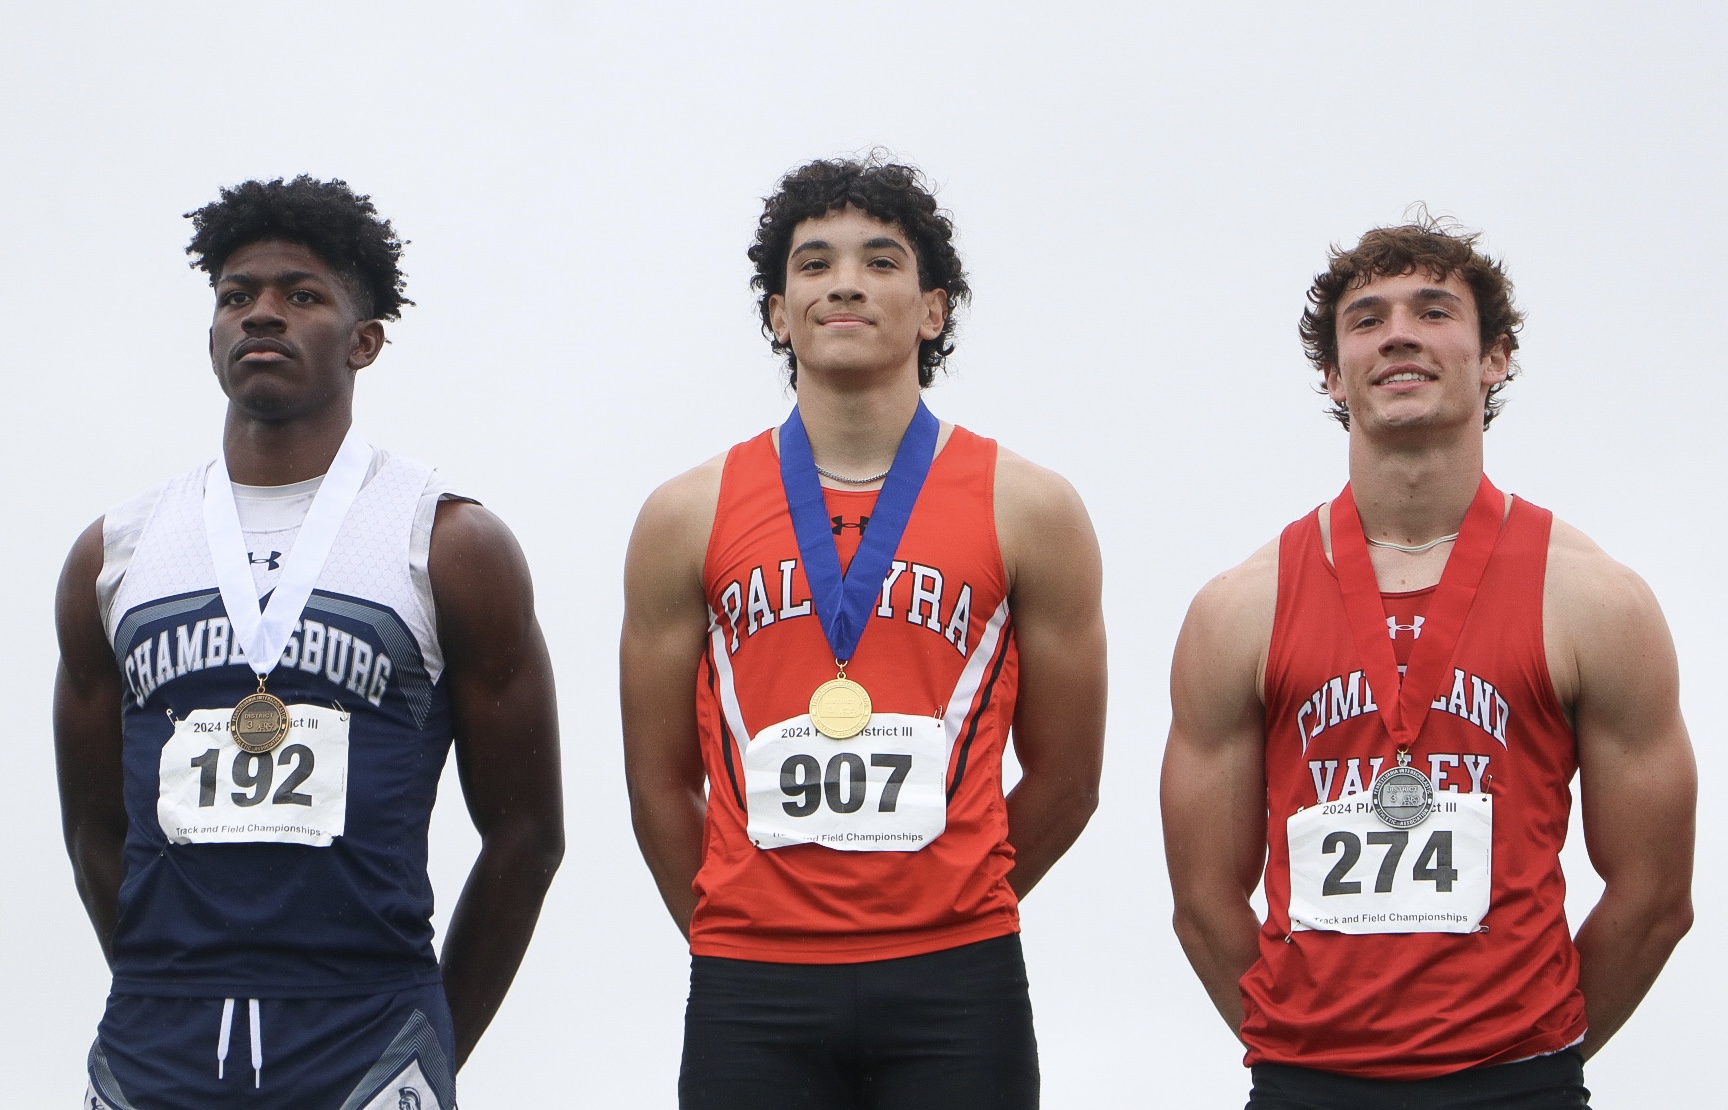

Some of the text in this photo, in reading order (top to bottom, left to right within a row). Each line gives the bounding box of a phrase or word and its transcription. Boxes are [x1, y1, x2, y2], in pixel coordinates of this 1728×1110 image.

[721, 559, 972, 657] PALYRA
[124, 616, 392, 707] CHAMBSBURG
[193, 721, 221, 733] 2024
[307, 718, 318, 729] III
[247, 720, 253, 729] 3
[781, 726, 810, 738] 2024
[902, 726, 913, 737] III
[190, 743, 315, 808] 192
[1308, 752, 1490, 802] VAEY
[779, 752, 912, 818] 907
[1386, 785, 1419, 793] DISTRICT
[1322, 803, 1352, 815] 2024
[1445, 802, 1457, 813] III
[176, 823, 320, 837] Track and Field Championships
[821, 833, 844, 842] Field
[846, 832, 923, 843] Championships
[1321, 830, 1458, 897] 274
[1341, 915, 1359, 923] and
[1362, 913, 1386, 922] Field
[1389, 912, 1468, 923] Championships
